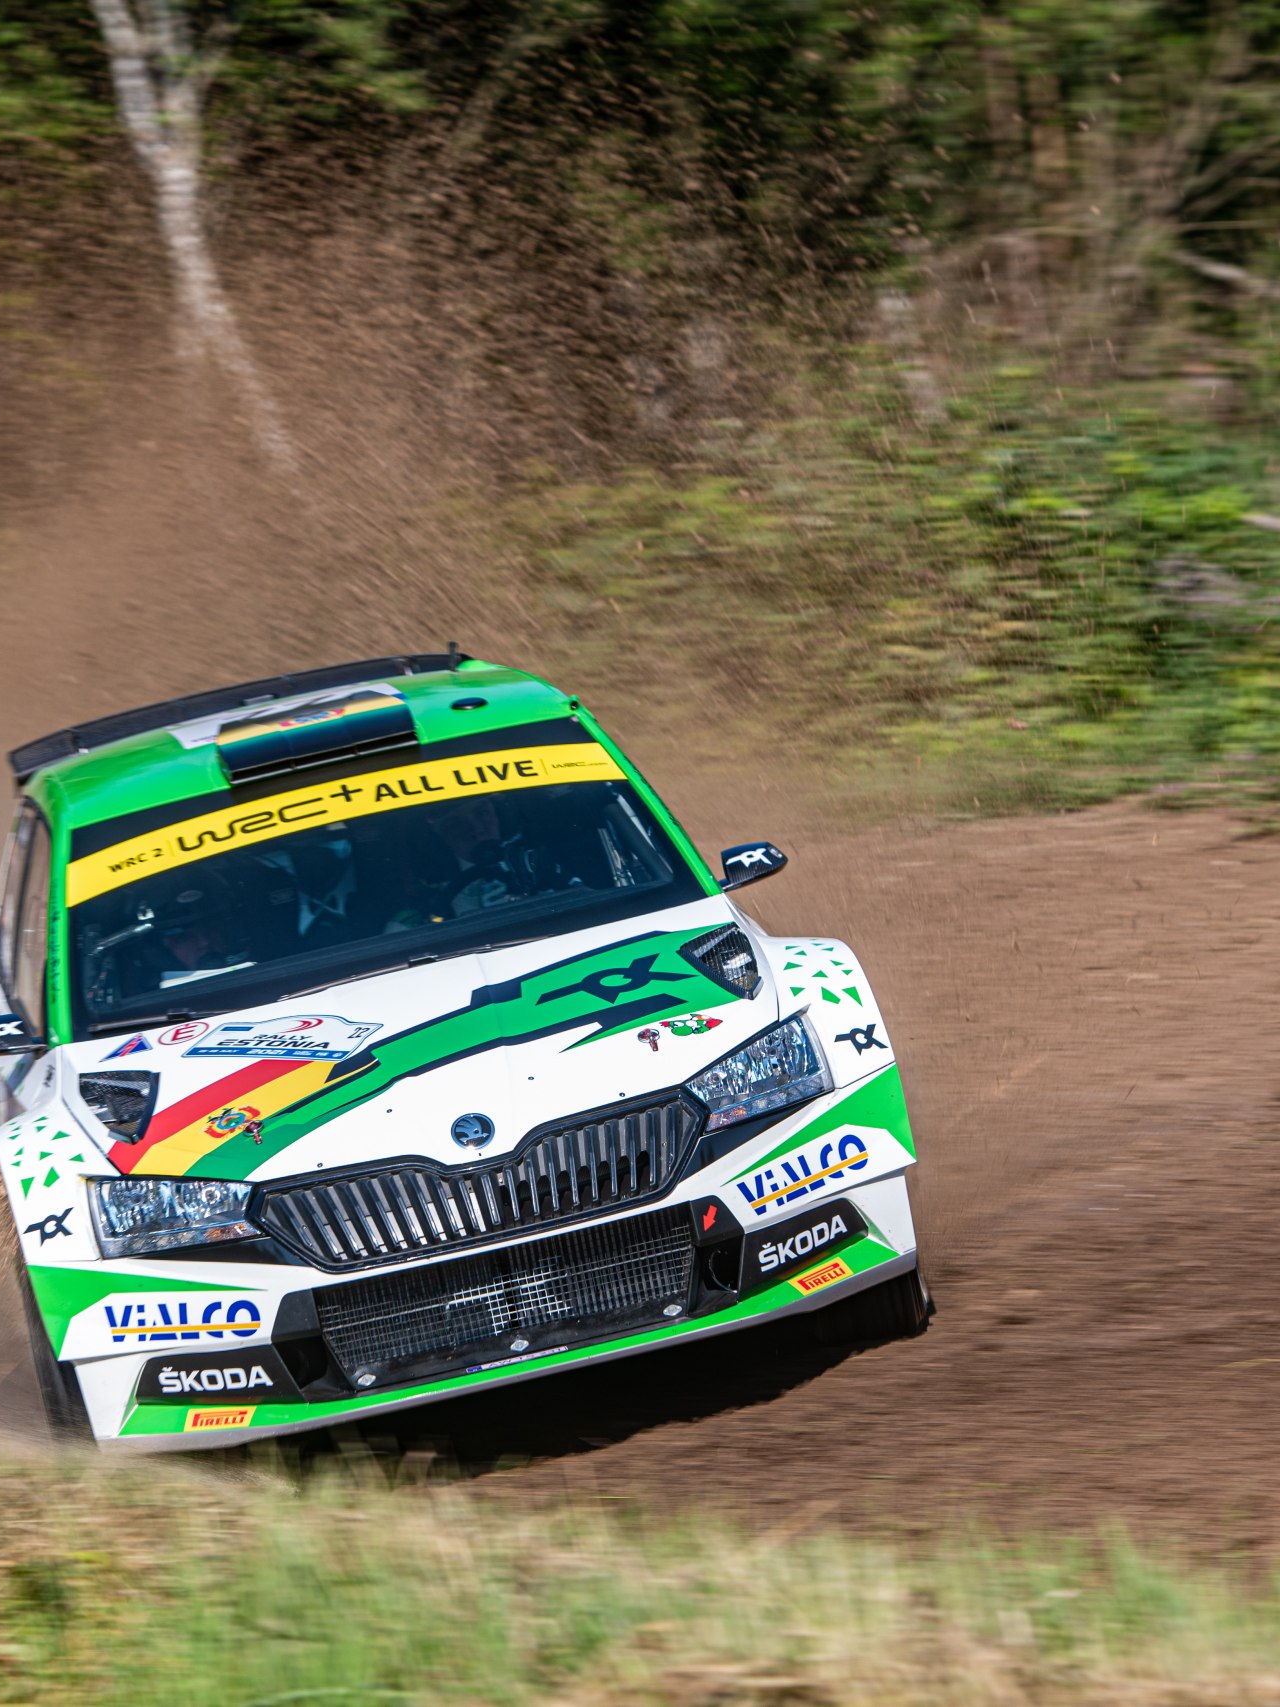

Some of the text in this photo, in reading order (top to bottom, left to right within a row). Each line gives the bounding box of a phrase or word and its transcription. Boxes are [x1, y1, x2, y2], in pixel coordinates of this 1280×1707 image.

[108, 853, 148, 873] WRC
[152, 848, 164, 858] 2
[375, 775, 444, 802] ALL
[453, 760, 539, 786] LIVE
[217, 1039, 331, 1050] ESTONIA
[253, 1033, 312, 1041] RALLY
[758, 1214, 848, 1273] ŠKODA
[797, 1262, 846, 1290] PIRELLI
[158, 1365, 273, 1393] ŠKODA
[191, 1410, 248, 1427] PIRELLI
